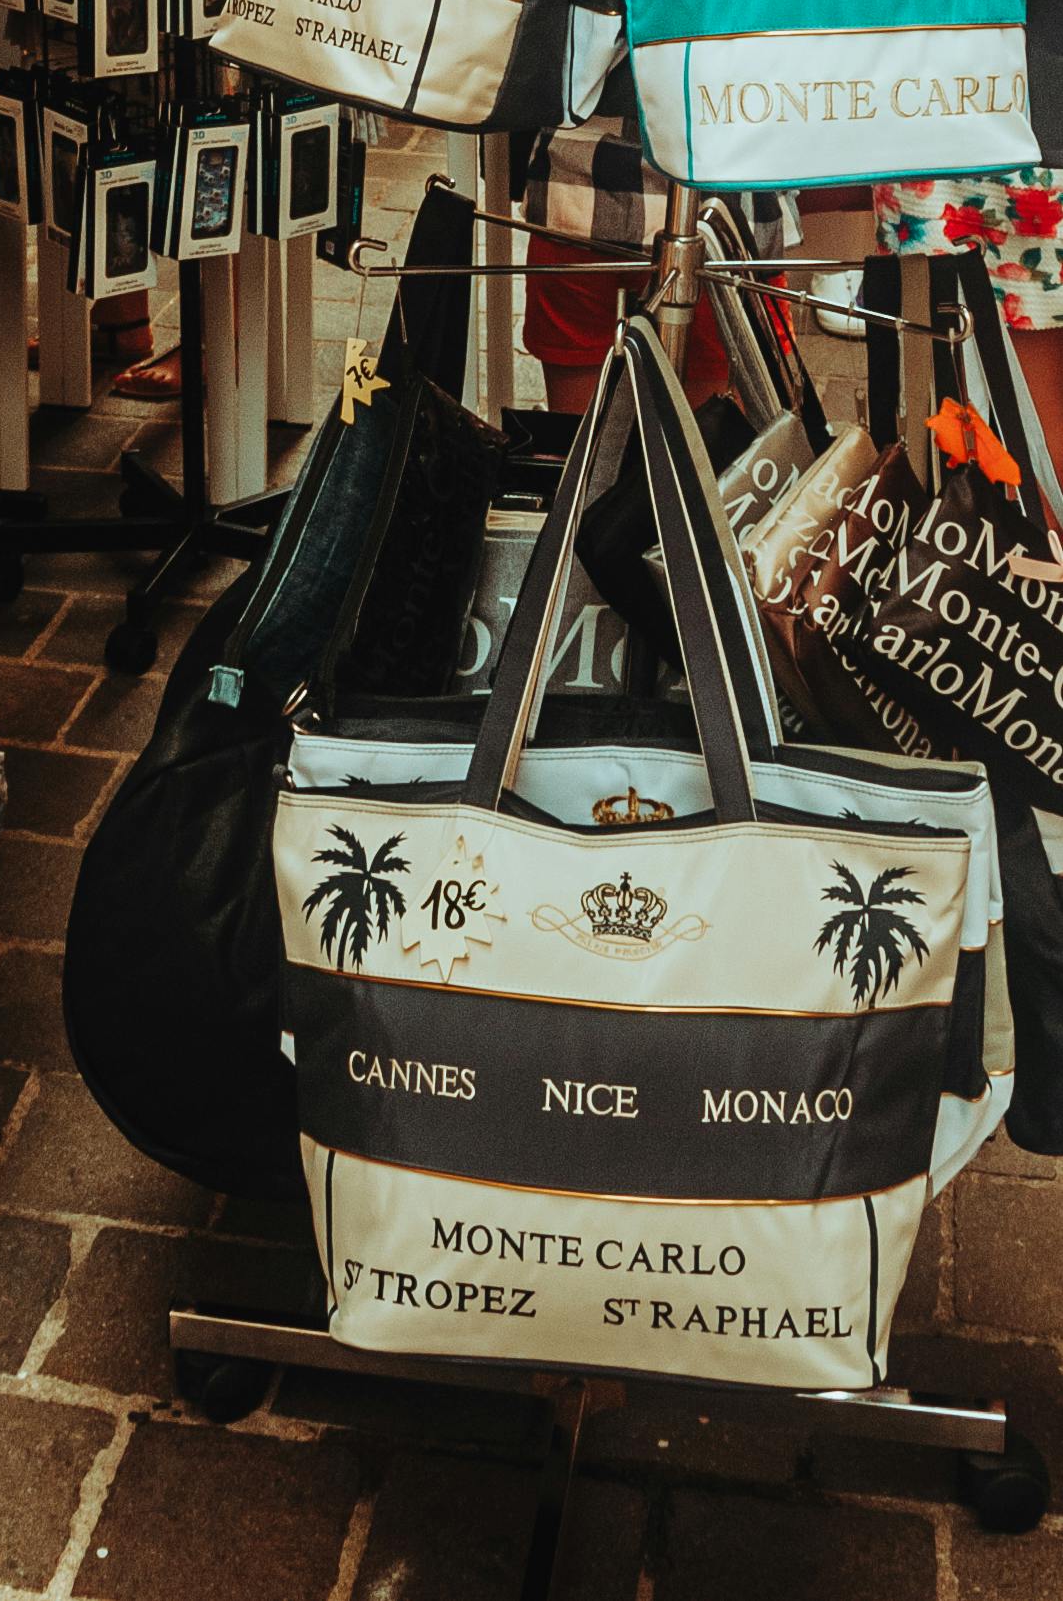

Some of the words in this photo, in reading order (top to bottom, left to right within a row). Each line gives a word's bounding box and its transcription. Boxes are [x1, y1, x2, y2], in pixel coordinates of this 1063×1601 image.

[311, 20, 408, 67] RAPHAEL
[697, 79, 879, 126] MONTE
[905, 71, 1027, 118] CARLO
[192, 131, 205, 140] 3D
[99, 170, 112, 179] 3D
[346, 359, 374, 389] 7€
[420, 879, 487, 930] 18€
[348, 1050, 477, 1100] CANNES
[541, 1078, 639, 1119] NICE
[701, 1087, 854, 1125] MONACO
[430, 1217, 584, 1268] MONTE
[595, 1239, 747, 1276] CARLO
[369, 1268, 537, 1318] TROPEZ
[650, 1300, 854, 1340] RAPHAEL
